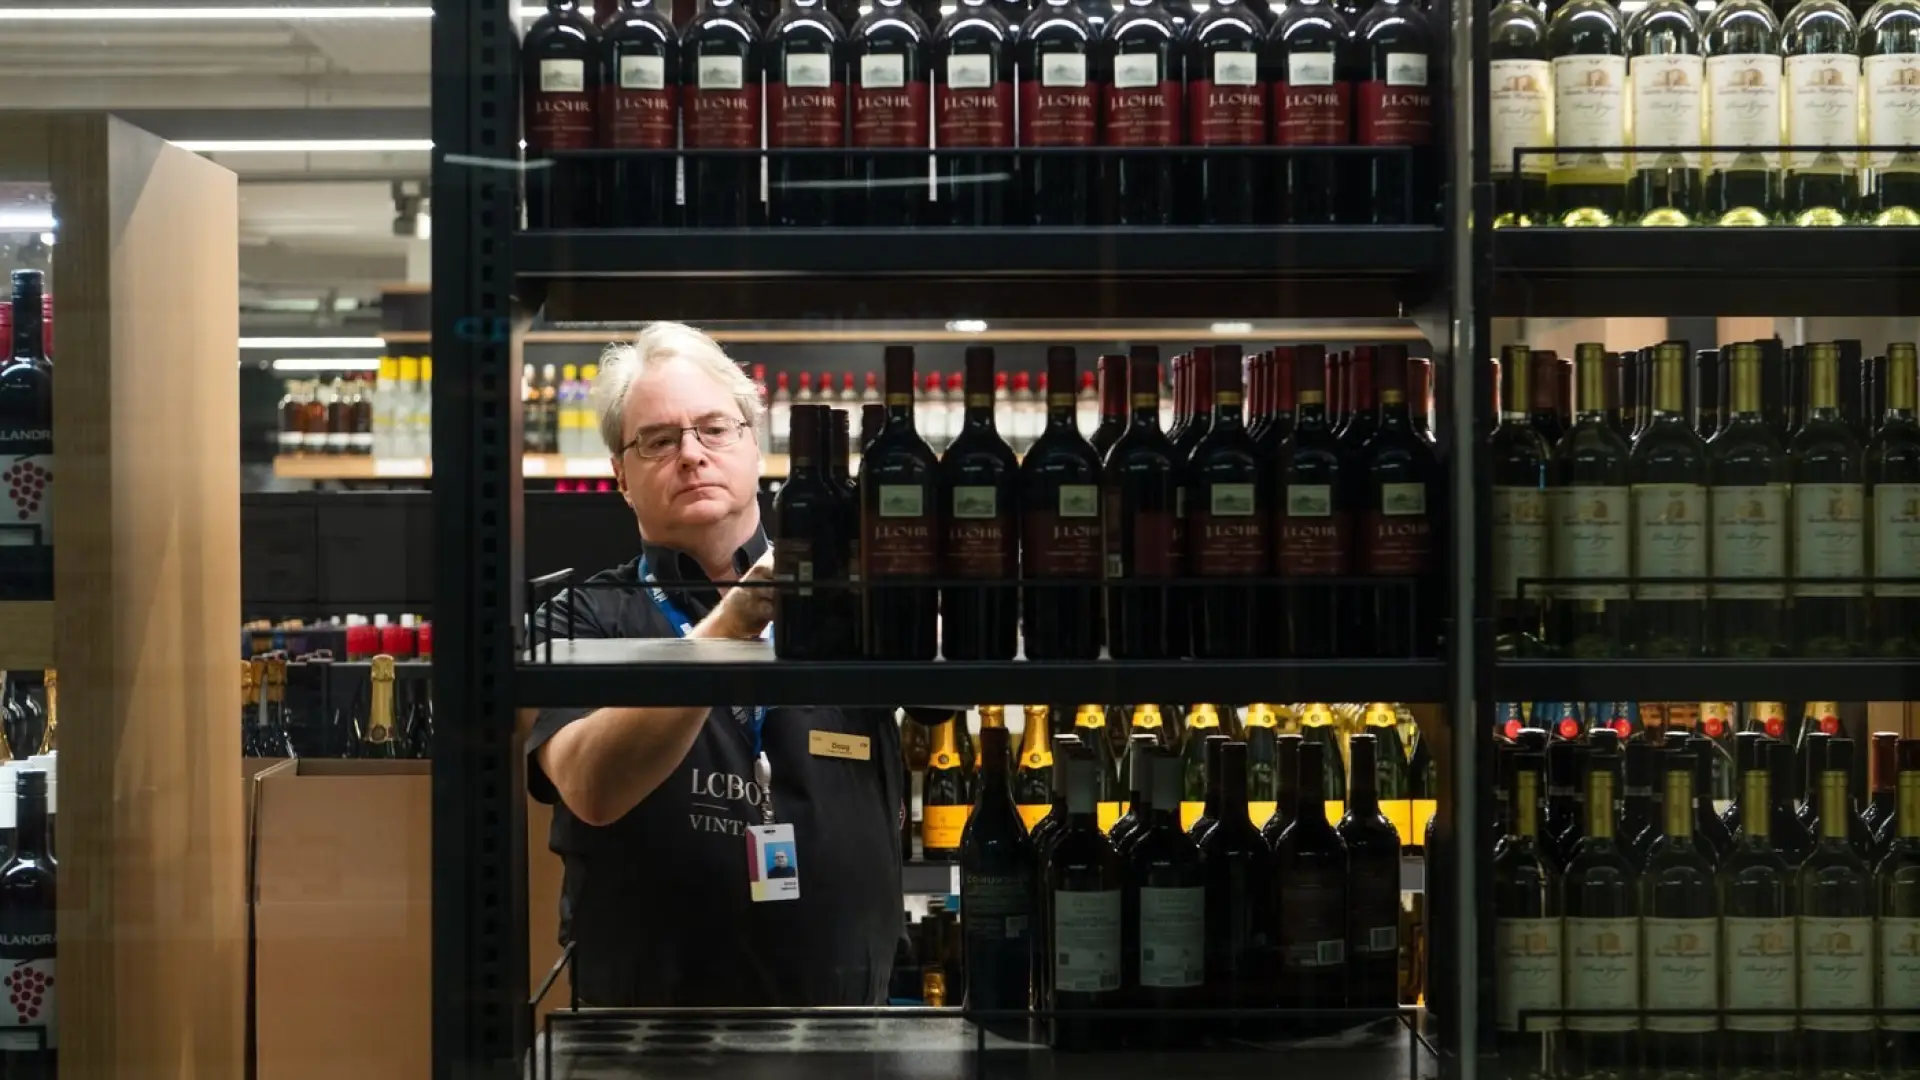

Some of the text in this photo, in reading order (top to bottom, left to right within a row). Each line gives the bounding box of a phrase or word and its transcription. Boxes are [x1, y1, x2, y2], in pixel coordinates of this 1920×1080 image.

[0, 430, 51, 441] LANDR
[691, 768, 761, 806] LCBO
[689, 814, 750, 836] VINT
[0, 934, 56, 946] LANDR
